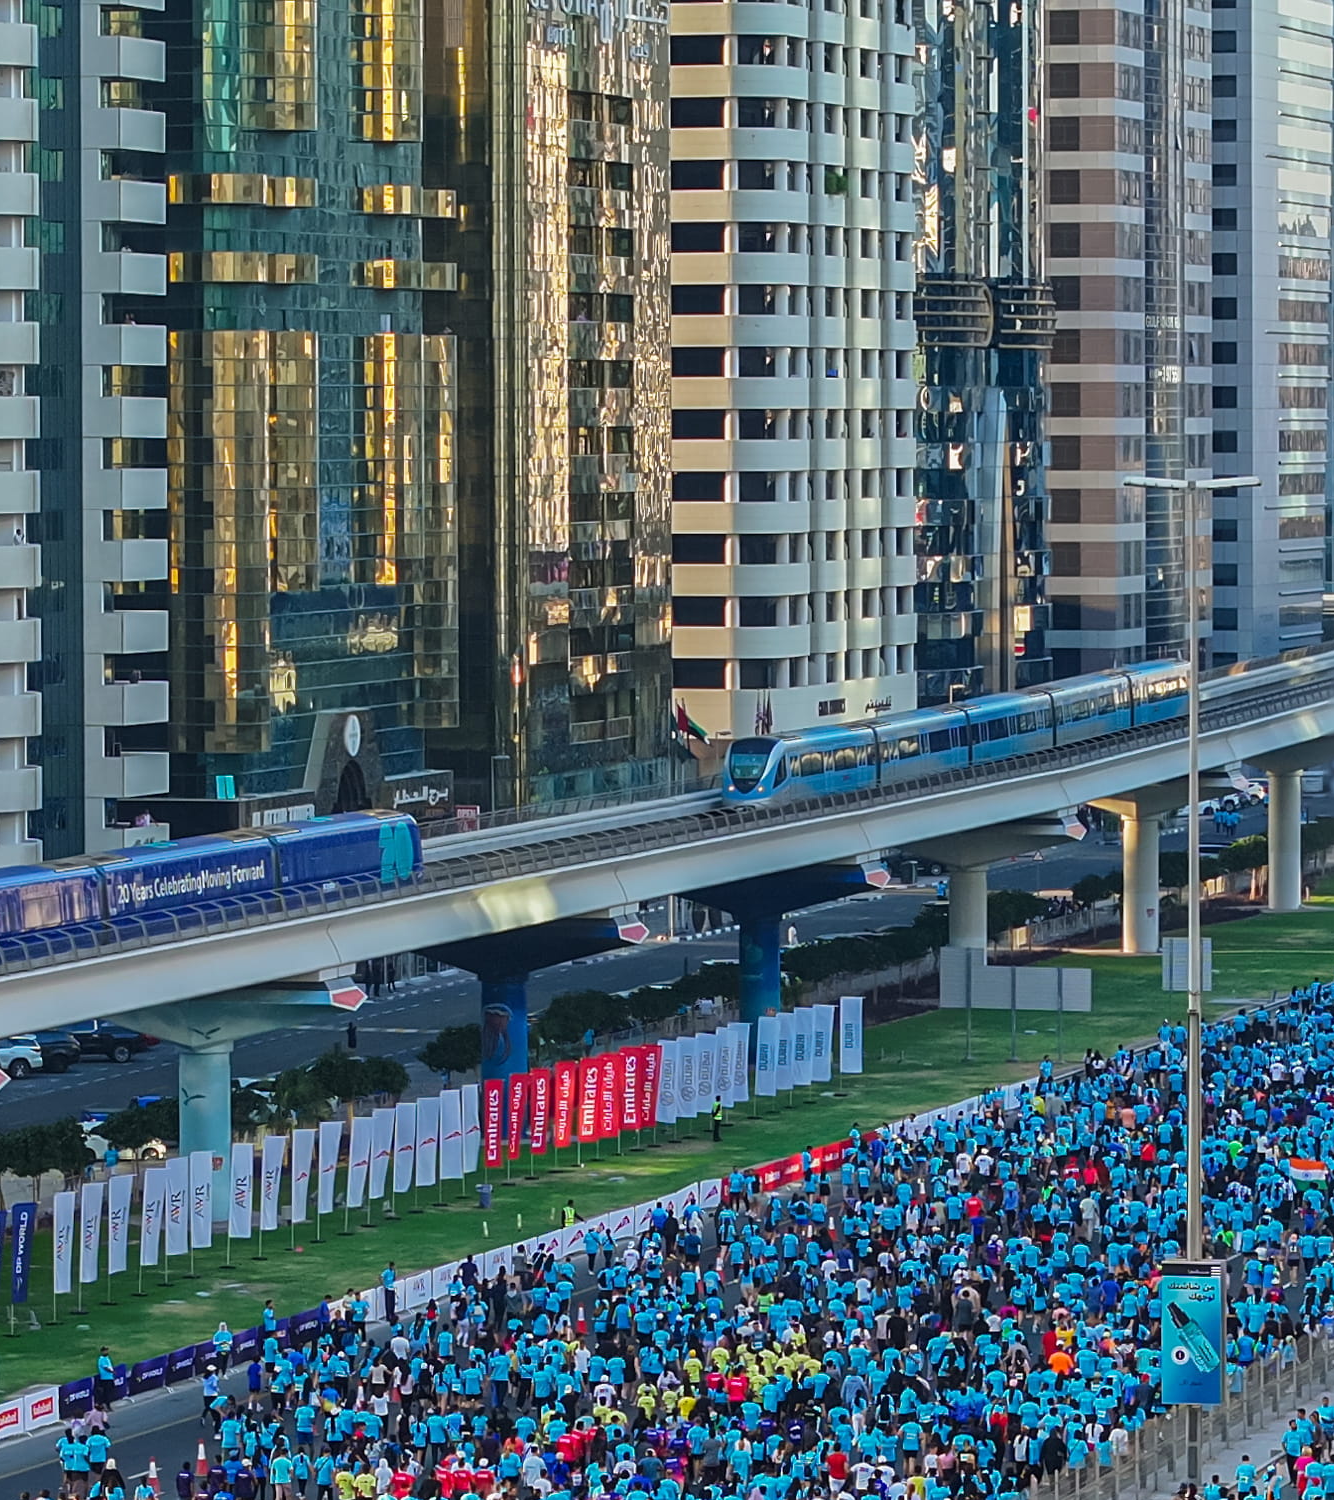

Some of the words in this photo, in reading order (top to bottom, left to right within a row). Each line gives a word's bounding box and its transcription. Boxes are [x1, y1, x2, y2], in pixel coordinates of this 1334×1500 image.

[117, 884, 130, 905] 20
[131, 881, 154, 901] Years
[154, 873, 203, 896] Celebrating
[201, 867, 232, 890] Moving
[232, 859, 266, 884] Forward
[581, 1067, 598, 1136] Emirates
[624, 1055, 637, 1124] Emirates
[487, 1089, 499, 1161] Emirates
